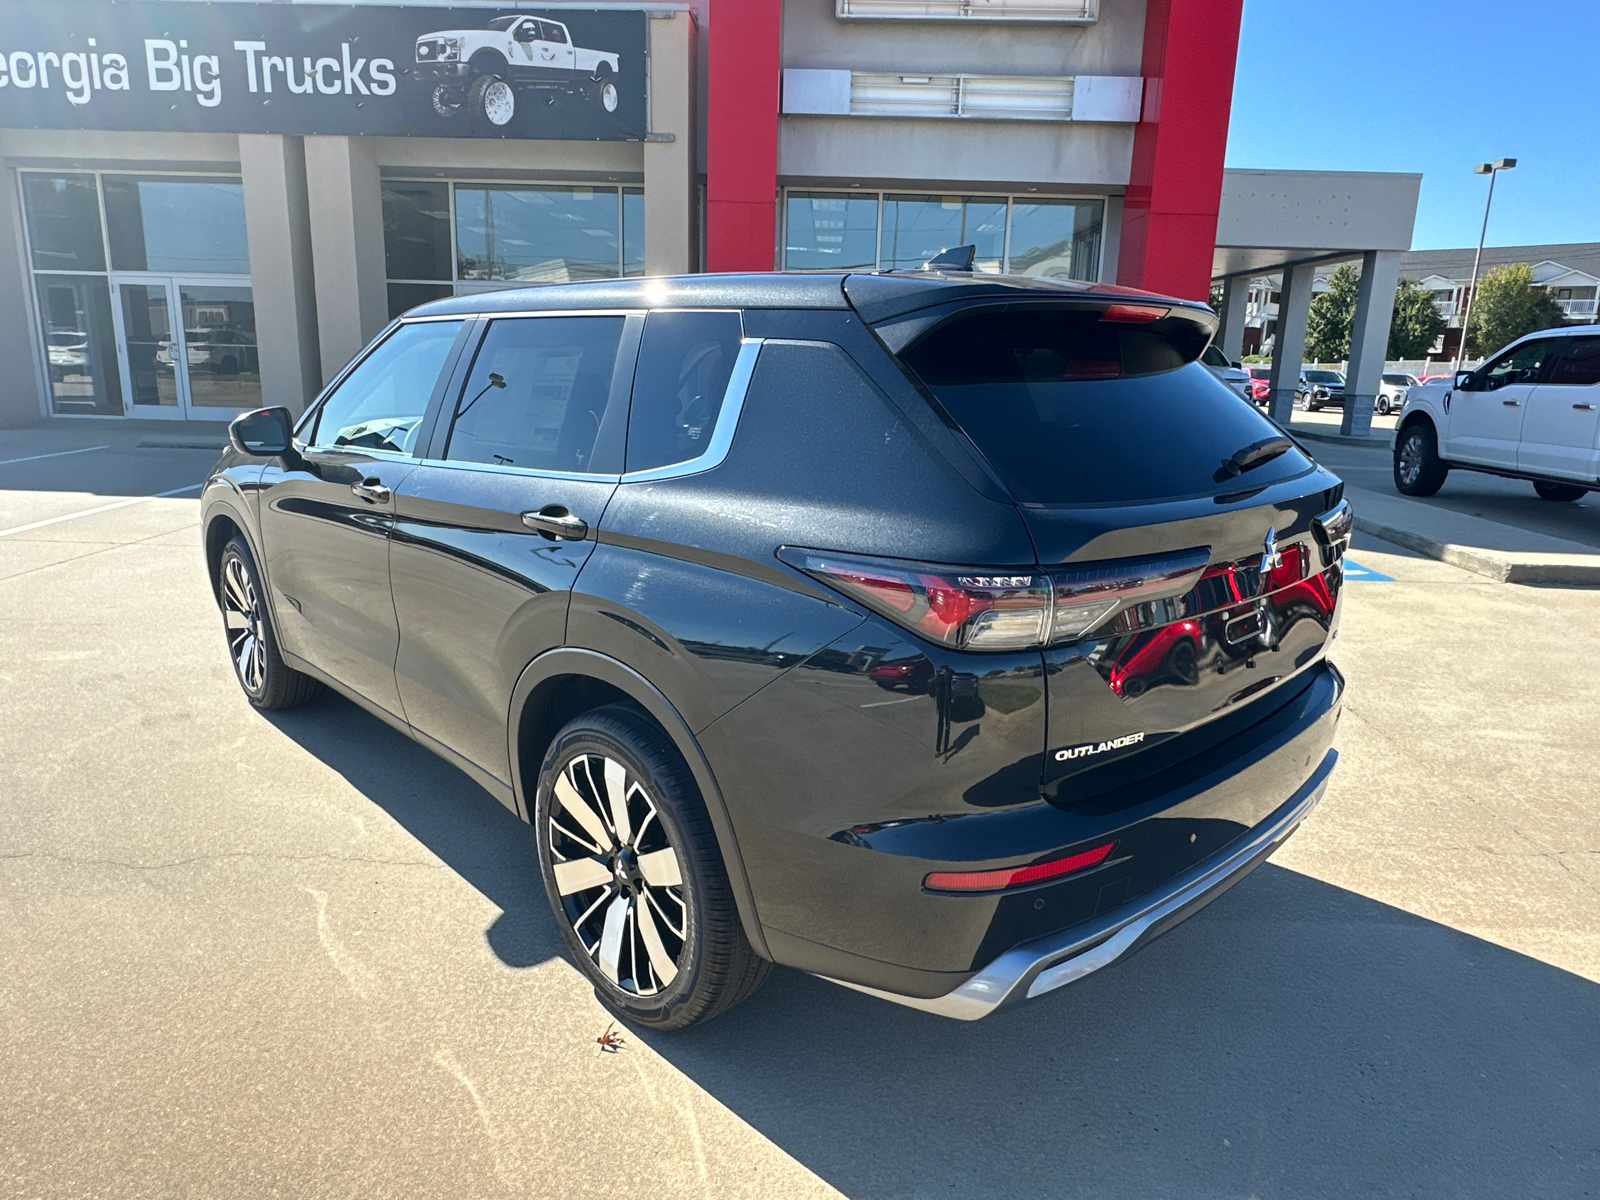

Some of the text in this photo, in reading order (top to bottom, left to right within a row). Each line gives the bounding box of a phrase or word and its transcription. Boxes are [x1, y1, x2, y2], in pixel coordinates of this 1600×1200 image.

[144, 39, 222, 107] Big
[234, 41, 397, 96] Trucks
[1055, 732, 1144, 761] OUTLANDER
